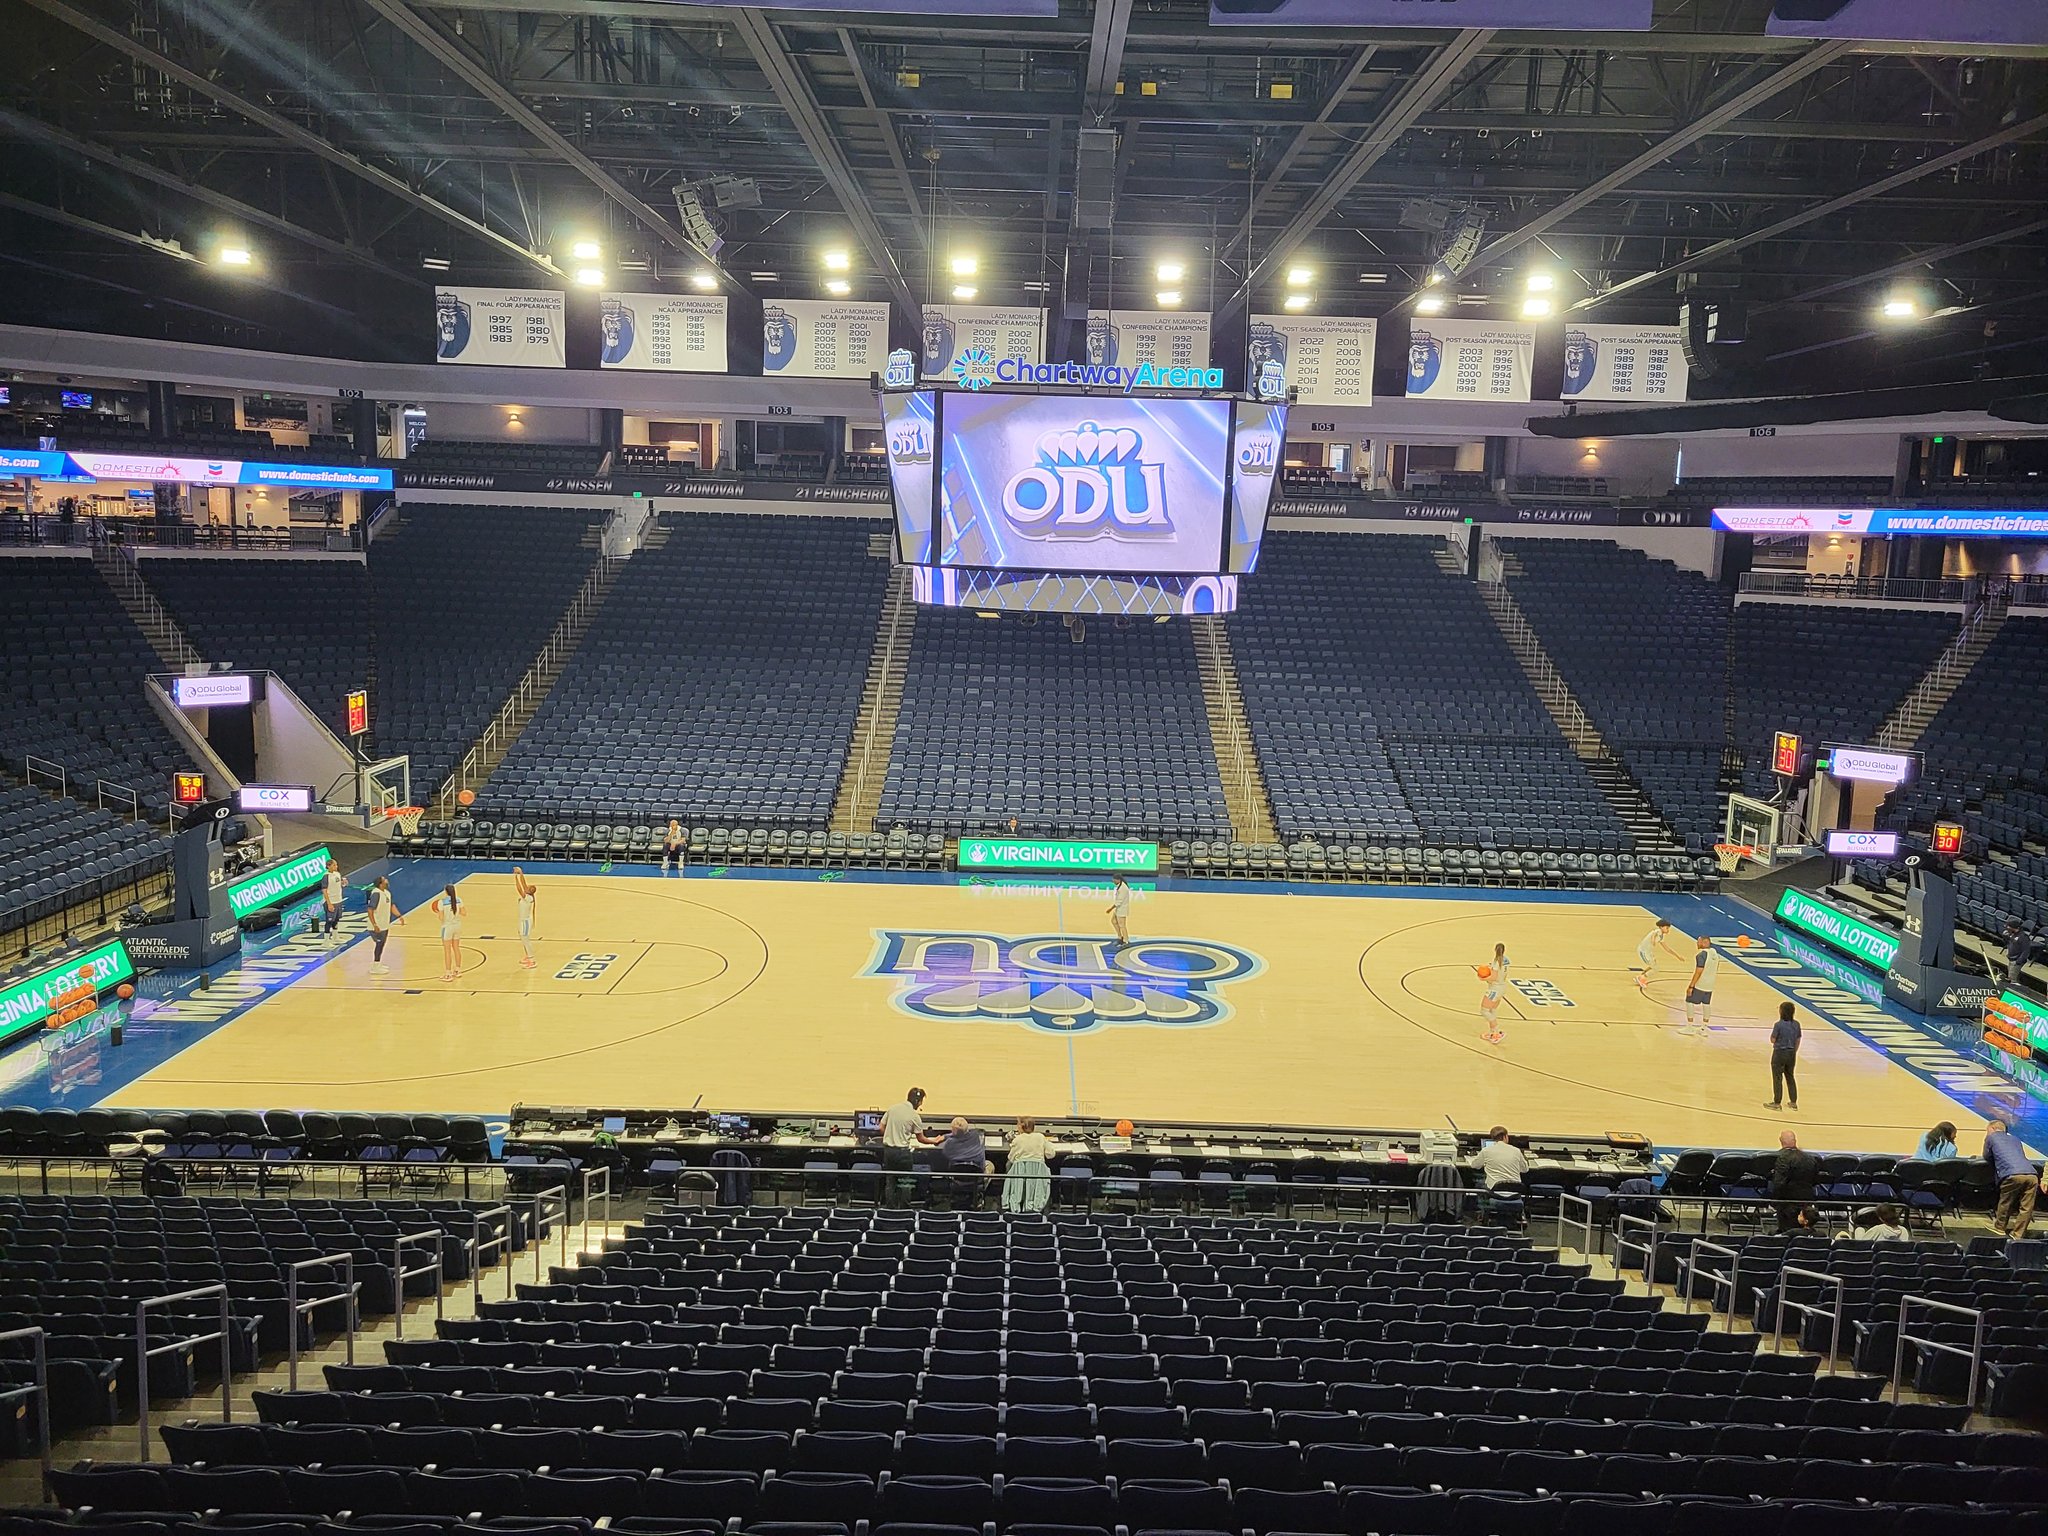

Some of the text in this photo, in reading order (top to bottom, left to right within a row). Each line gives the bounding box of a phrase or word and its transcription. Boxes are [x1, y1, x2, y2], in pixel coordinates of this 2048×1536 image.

[886, 366, 912, 383] ODU
[1261, 377, 1284, 396] ODU
[771, 406, 788, 414] 103
[408, 428, 425, 441] 44
[891, 436, 930, 457] ODU
[1238, 447, 1274, 467] ODU
[93, 464, 163, 472] DOMESTIC
[259, 470, 379, 483] www.domesticfuels.com
[403, 474, 494, 487] 10 LIEBERMAN
[547, 480, 612, 492] 42 NISSEN
[664, 483, 744, 496] 22 DONOVAN
[795, 488, 888, 500] 21 PENICHEIRO
[1002, 463, 1169, 527] ODU
[1271, 502, 1347, 515] CHANGUANA
[1404, 506, 1459, 518] 13 DIXON
[1517, 510, 1592, 522] 15 CLAXTON
[1872, 762, 1898, 770] Global
[182, 786, 197, 798] 30
[260, 790, 289, 800] COX
[1848, 835, 1877, 844] COX
[1938, 836, 1952, 848] 30
[991, 845, 1150, 865] VIRGINIA LOTTERY
[230, 855, 327, 909] VIRGINIA LOTTERY
[216, 925, 238, 940] Chartway
[1797, 902, 1898, 962] VIRGINIA LOTTERY
[1895, 973, 1918, 991] Chartway
[1767, 975, 2026, 1093] DOMINION
